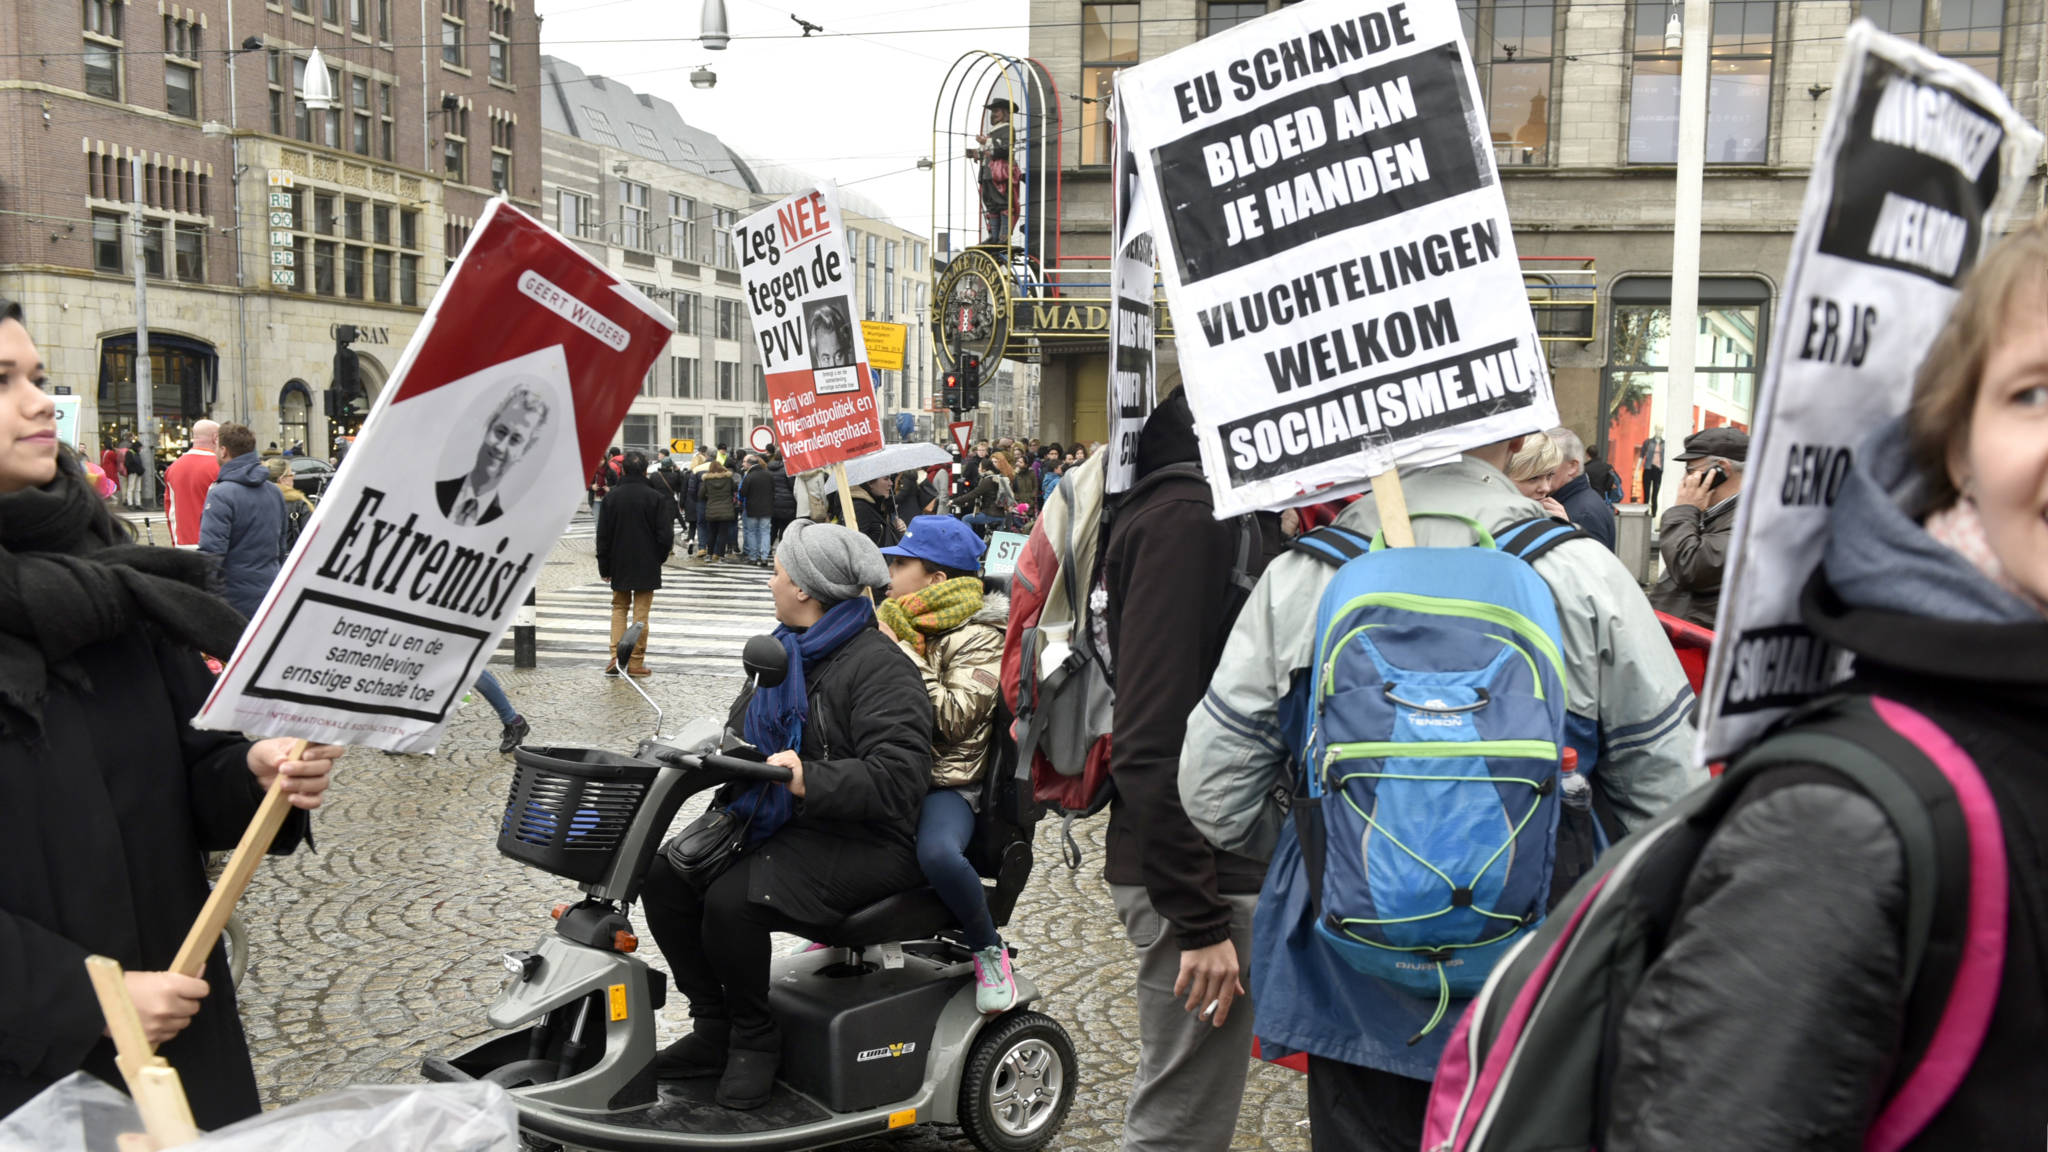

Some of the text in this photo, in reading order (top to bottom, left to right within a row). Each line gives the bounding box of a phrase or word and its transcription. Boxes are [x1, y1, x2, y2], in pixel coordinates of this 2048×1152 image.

[1173, 2, 1416, 125] EU SCHANDE
[1202, 75, 1418, 188] BLOED AAN
[1223, 136, 1431, 248] JE HANDEN
[736, 189, 831, 268] Zeg NEE
[525, 277, 625, 346] GEERT WILDERS
[748, 243, 842, 318] tegen de
[1196, 217, 1502, 348] VLUCHTELINGEN
[760, 315, 803, 368] PVV
[1264, 297, 1460, 394] WELKOM
[1798, 295, 1877, 368] ER IS
[773, 390, 816, 416] Partij van
[776, 395, 873, 438] Vrijemarktpolitiek en
[781, 416, 873, 459] Vreemdelingenhaat
[1228, 349, 1535, 471] SOCIALISME.NU
[1781, 443, 1853, 507] GENO
[316, 486, 535, 622] Extremist
[997, 541, 1021, 561] ST
[325, 645, 425, 681] samenleving
[332, 616, 444, 656] brengt u en de
[281, 664, 436, 703] ernstige schade toe
